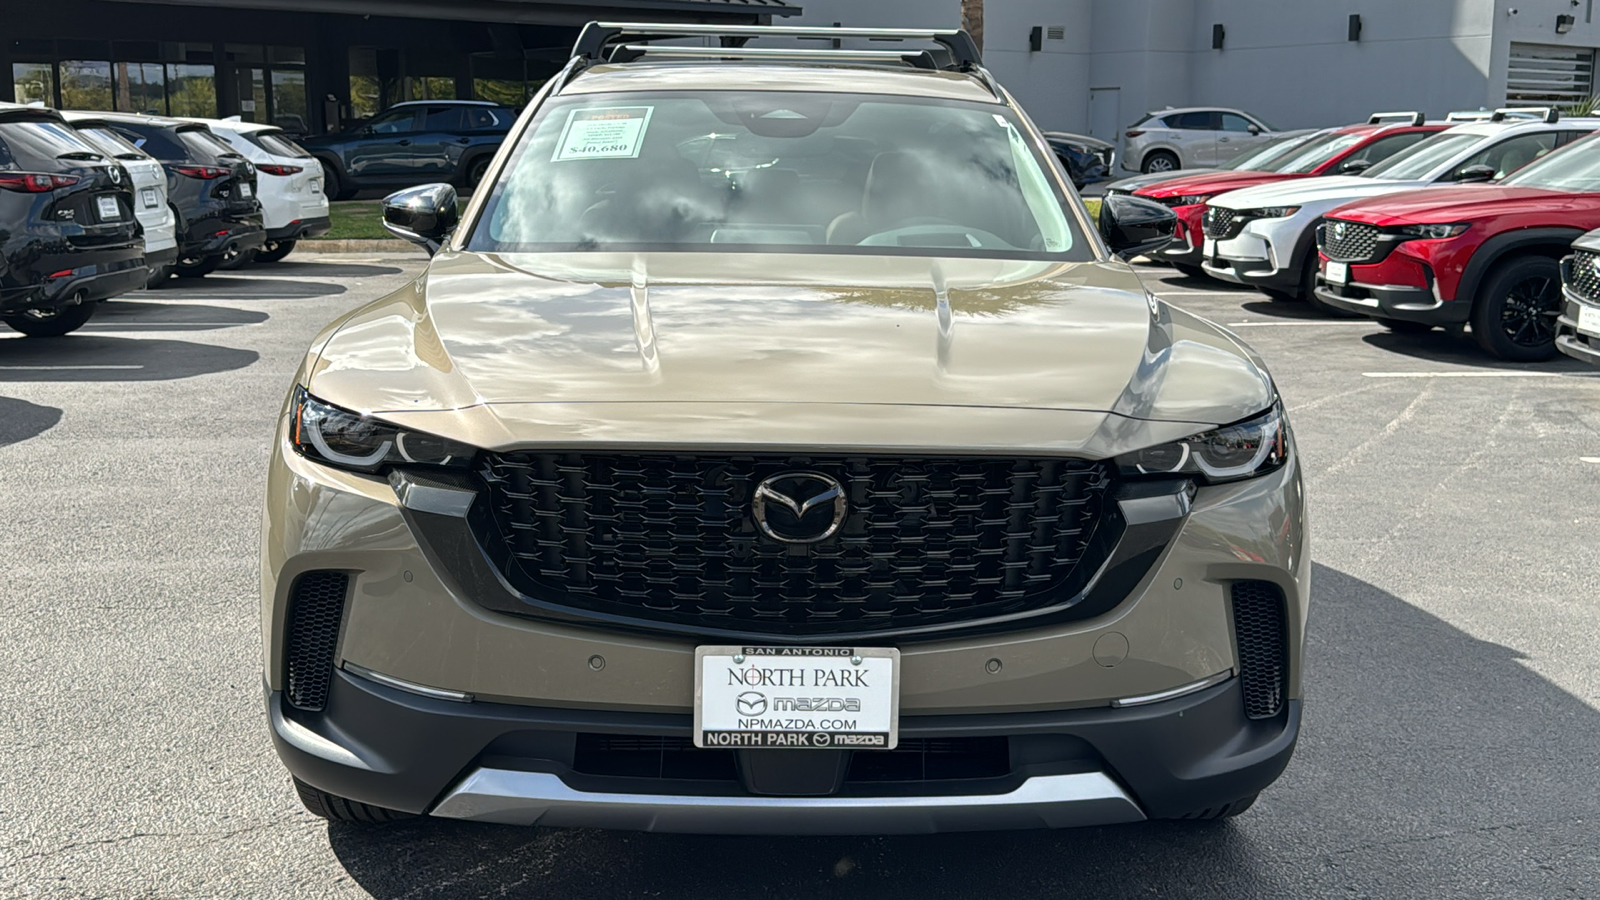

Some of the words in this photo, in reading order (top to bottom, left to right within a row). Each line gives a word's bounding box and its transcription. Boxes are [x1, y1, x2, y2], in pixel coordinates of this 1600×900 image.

[782, 648, 851, 656] ANTONIO
[727, 667, 806, 688] NORTH
[813, 668, 870, 688] PARK
[773, 697, 861, 712] mazda
[738, 719, 857, 730] NPMAZDA.COM
[707, 733, 762, 746] NORTH
[767, 733, 809, 746] PARK
[834, 735, 884, 745] mazda
